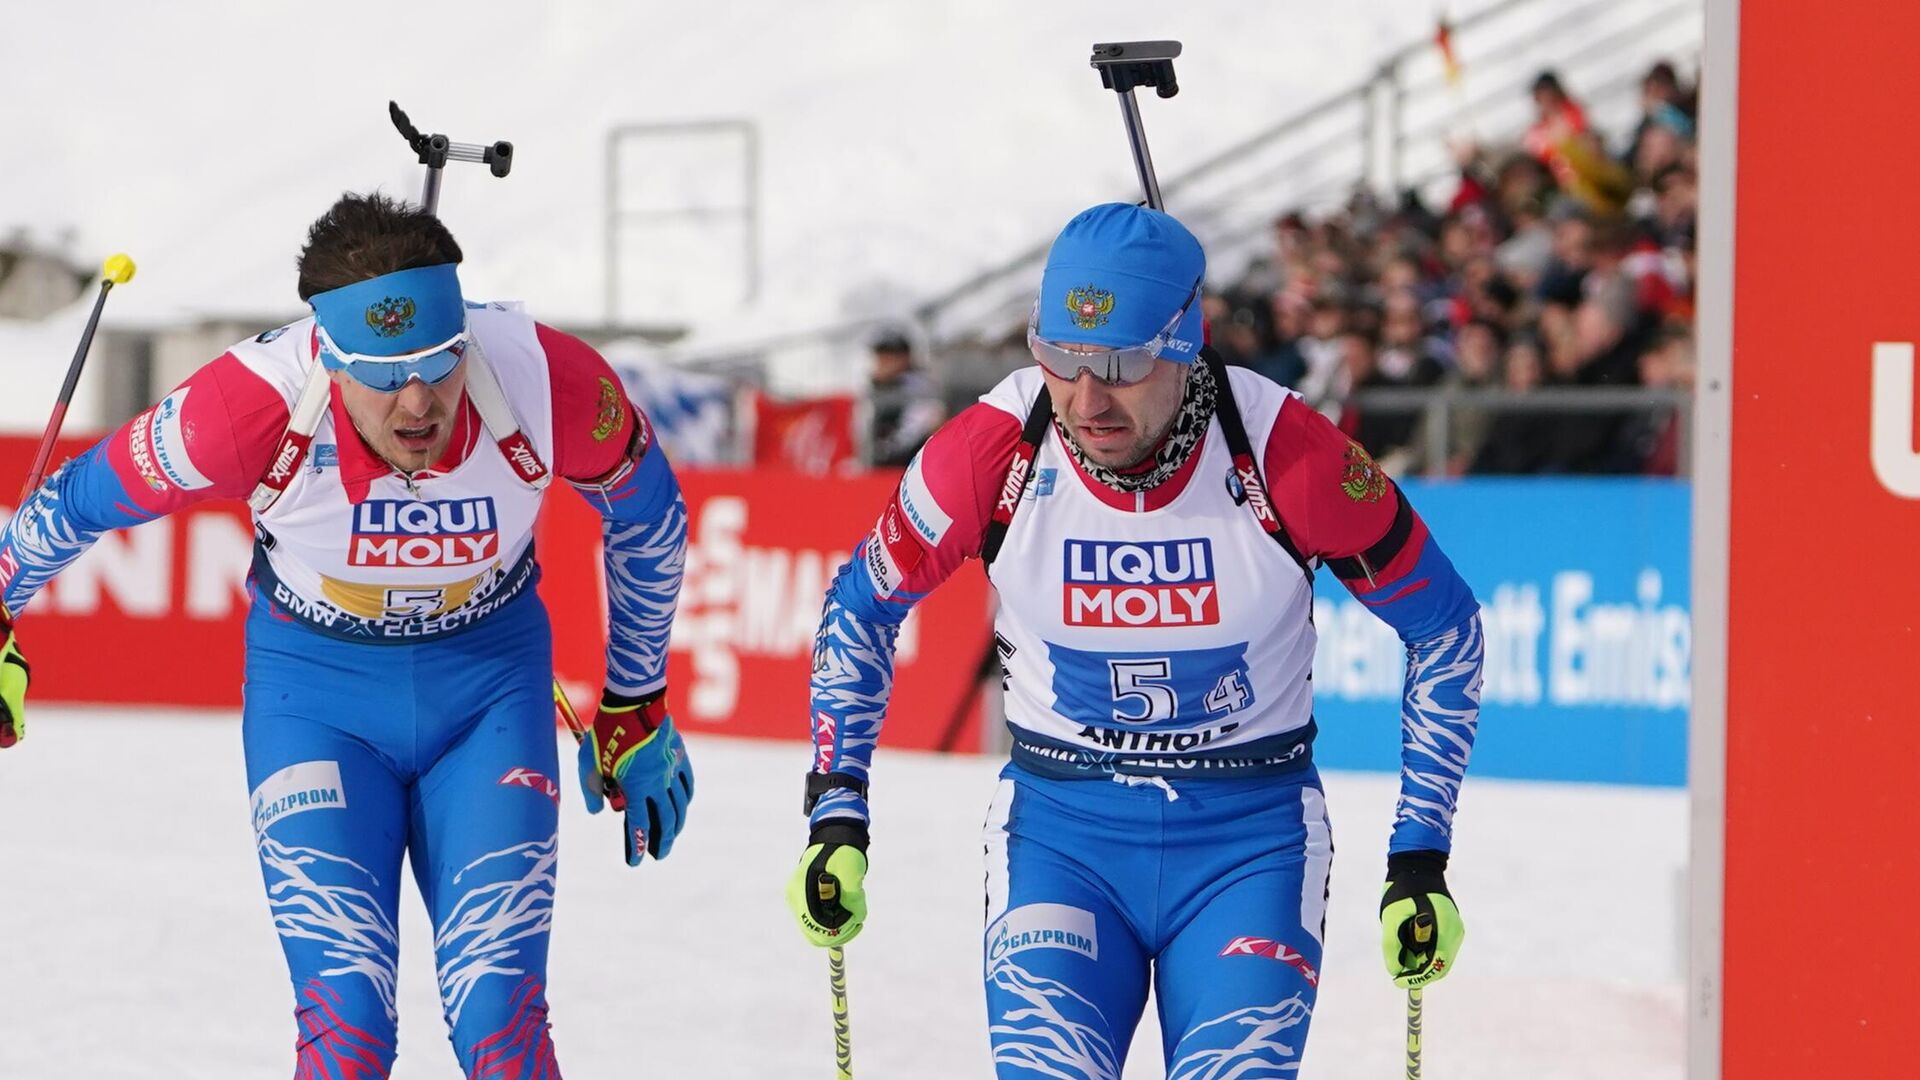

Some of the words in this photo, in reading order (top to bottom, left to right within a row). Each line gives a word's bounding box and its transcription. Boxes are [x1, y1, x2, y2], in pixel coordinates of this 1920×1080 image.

[360, 502, 490, 534] LIQUI
[355, 533, 496, 566] MOLY
[1070, 543, 1207, 584] LIQUI
[274, 582, 337, 627] BMW
[384, 588, 446, 619] 5
[1071, 586, 1214, 625] MOLY
[1107, 658, 1177, 724] 5
[1203, 669, 1250, 715] 4
[602, 725, 627, 774] LEKI
[265, 788, 339, 822] GAZPROM
[1010, 929, 1092, 954] GAZPROM
